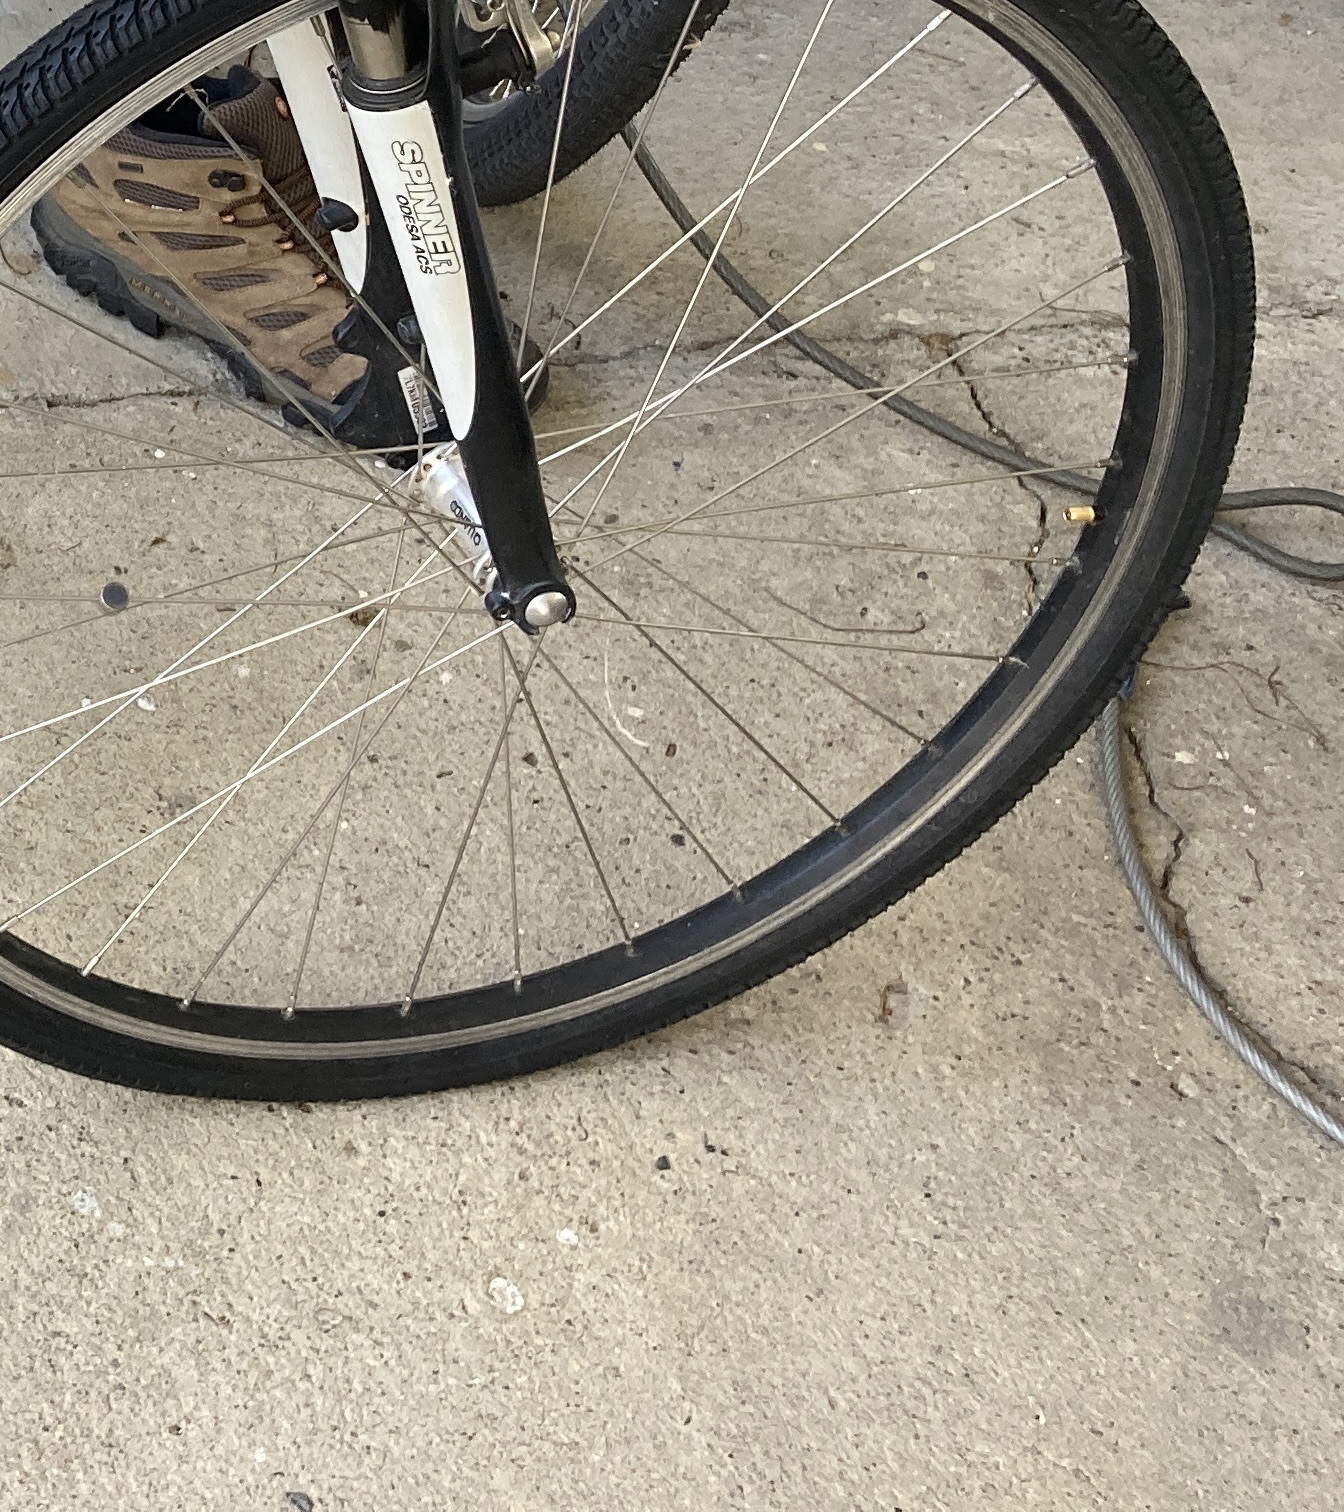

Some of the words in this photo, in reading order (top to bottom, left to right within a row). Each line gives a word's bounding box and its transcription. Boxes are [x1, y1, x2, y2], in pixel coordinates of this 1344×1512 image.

[391, 140, 461, 276] SPINNER
[396, 194, 419, 241] ODESA
[413, 245, 433, 275] ACS
